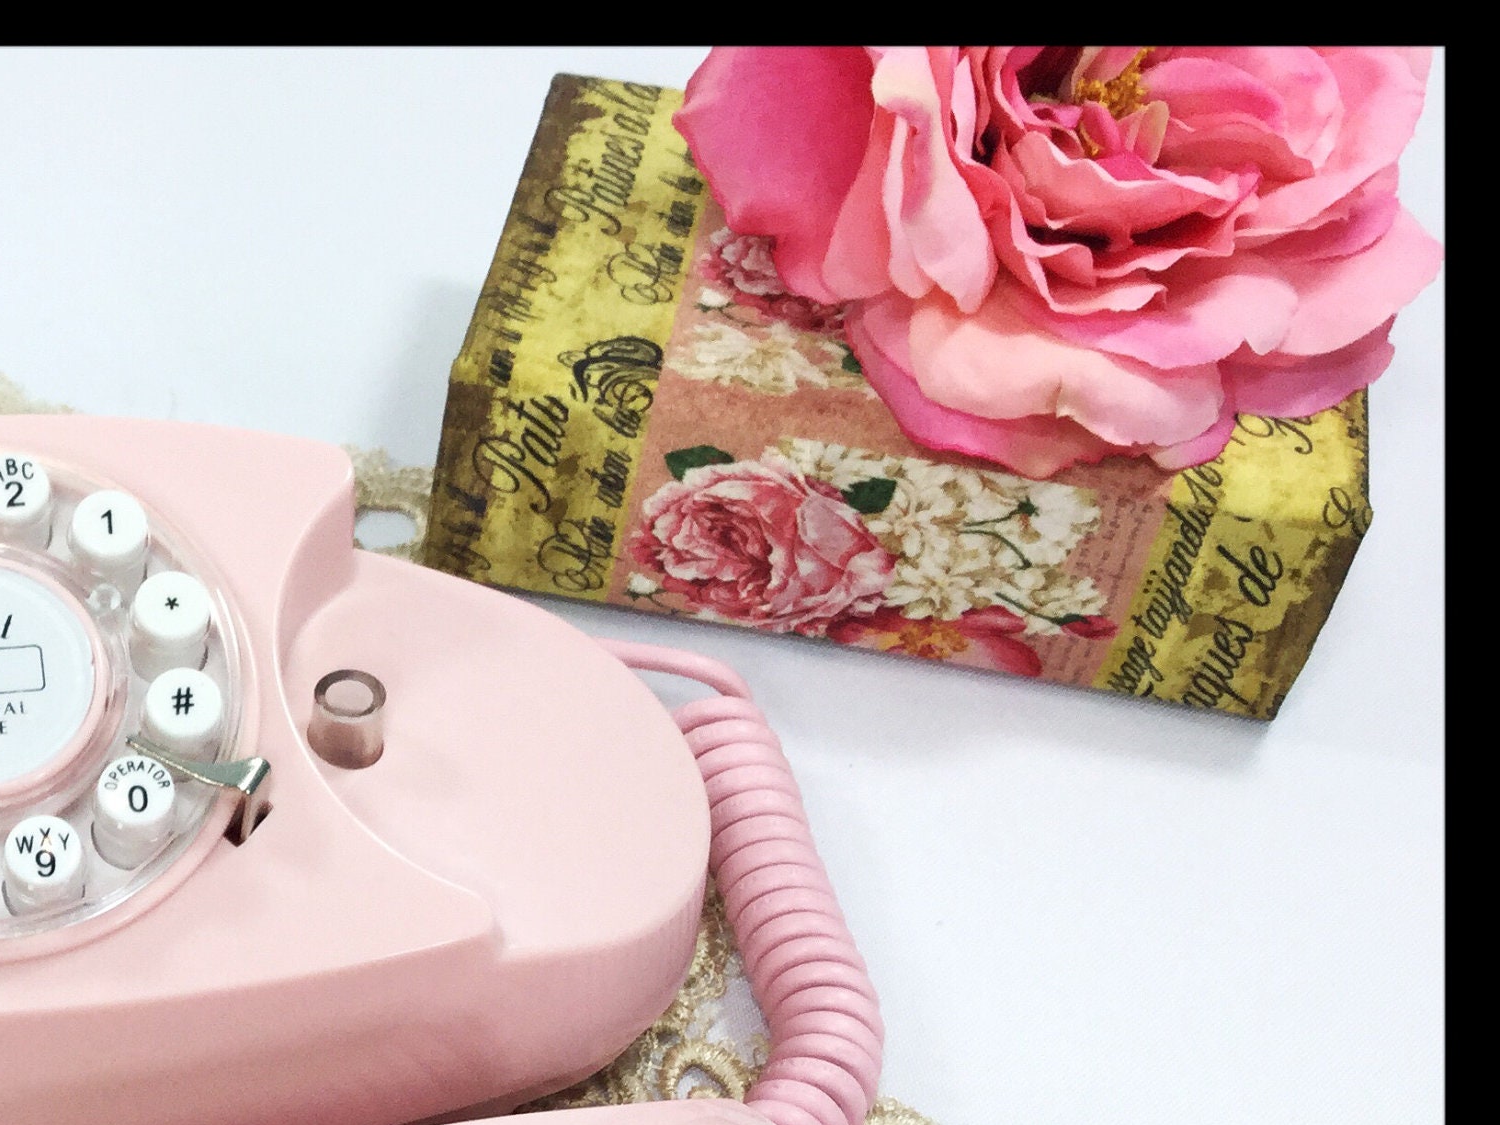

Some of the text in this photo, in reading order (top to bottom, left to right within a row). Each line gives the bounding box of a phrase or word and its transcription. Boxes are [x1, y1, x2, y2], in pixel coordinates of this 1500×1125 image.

[5, 481, 26, 509] 2
[100, 508, 114, 535] 1
[1215, 545, 1284, 607] de
[104, 760, 171, 790] OPERATOR
[15, 827, 71, 854] WXY
[34, 849, 57, 878] 9
